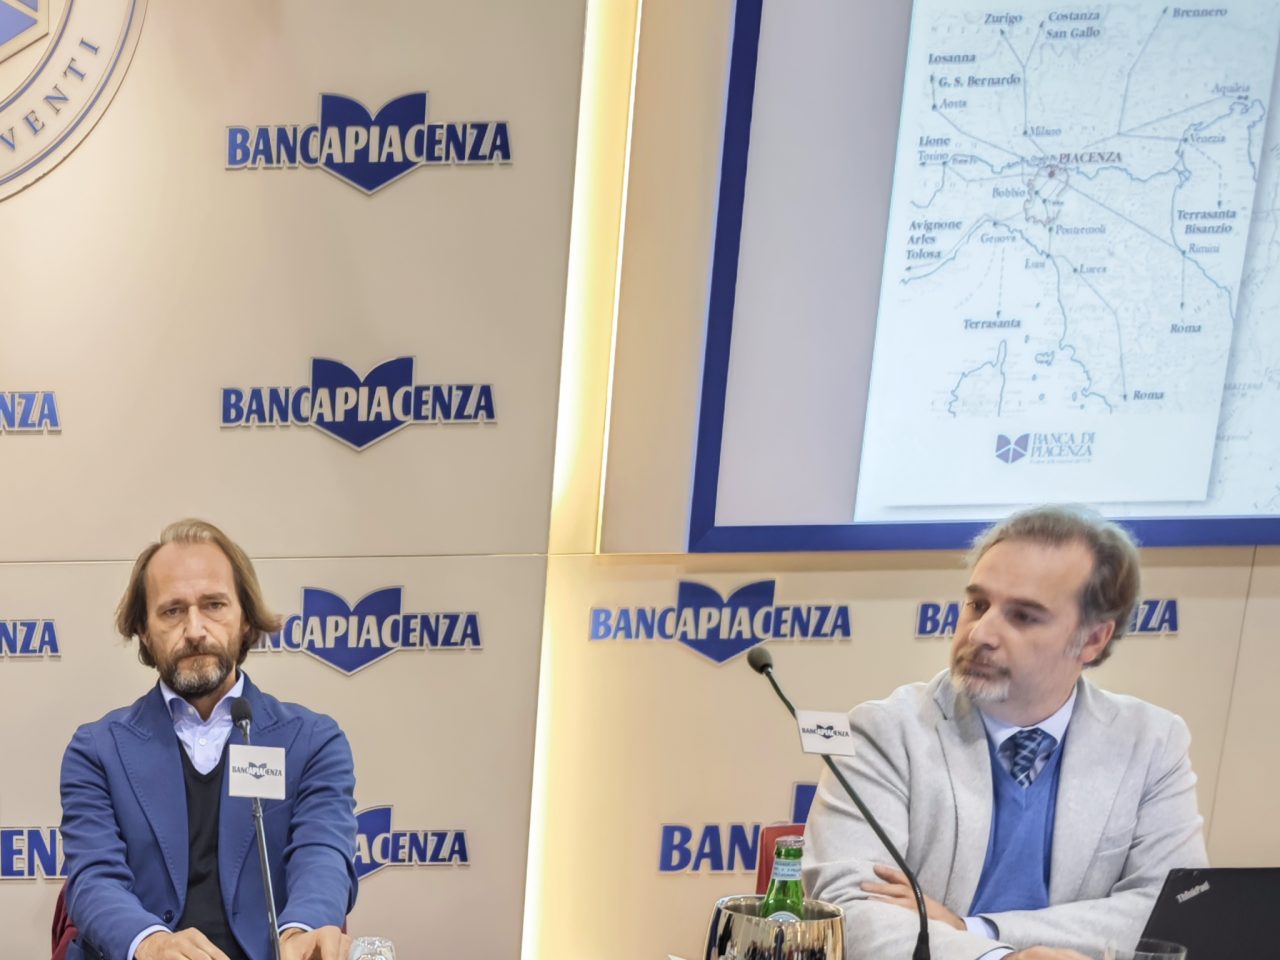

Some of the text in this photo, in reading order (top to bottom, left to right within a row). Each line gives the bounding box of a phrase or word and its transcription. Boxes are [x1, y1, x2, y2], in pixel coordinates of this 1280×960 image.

[1048, 11, 1101, 22] Costanza
[1172, 7, 1228, 18] Brennero
[984, 12, 1023, 27] Zurigo
[1045, 28, 1067, 39] San
[1070, 27, 1101, 39] Gallo
[928, 53, 976, 65] Losanna
[967, 74, 1021, 88] Bernardo
[225, 121, 513, 168] BANCAPIACENZA
[1060, 152, 1122, 163] PIACENZA
[1177, 209, 1237, 220] Terrasanta
[909, 219, 962, 233] Avignone
[1184, 223, 1233, 235] Bisanzio
[963, 317, 1022, 330] Terrasanta
[1170, 323, 1202, 334] Roma
[1133, 390, 1165, 401] Roma
[221, 383, 496, 425] BANCAPIACENZA
[590, 605, 852, 641] BANCAPIACENZA
